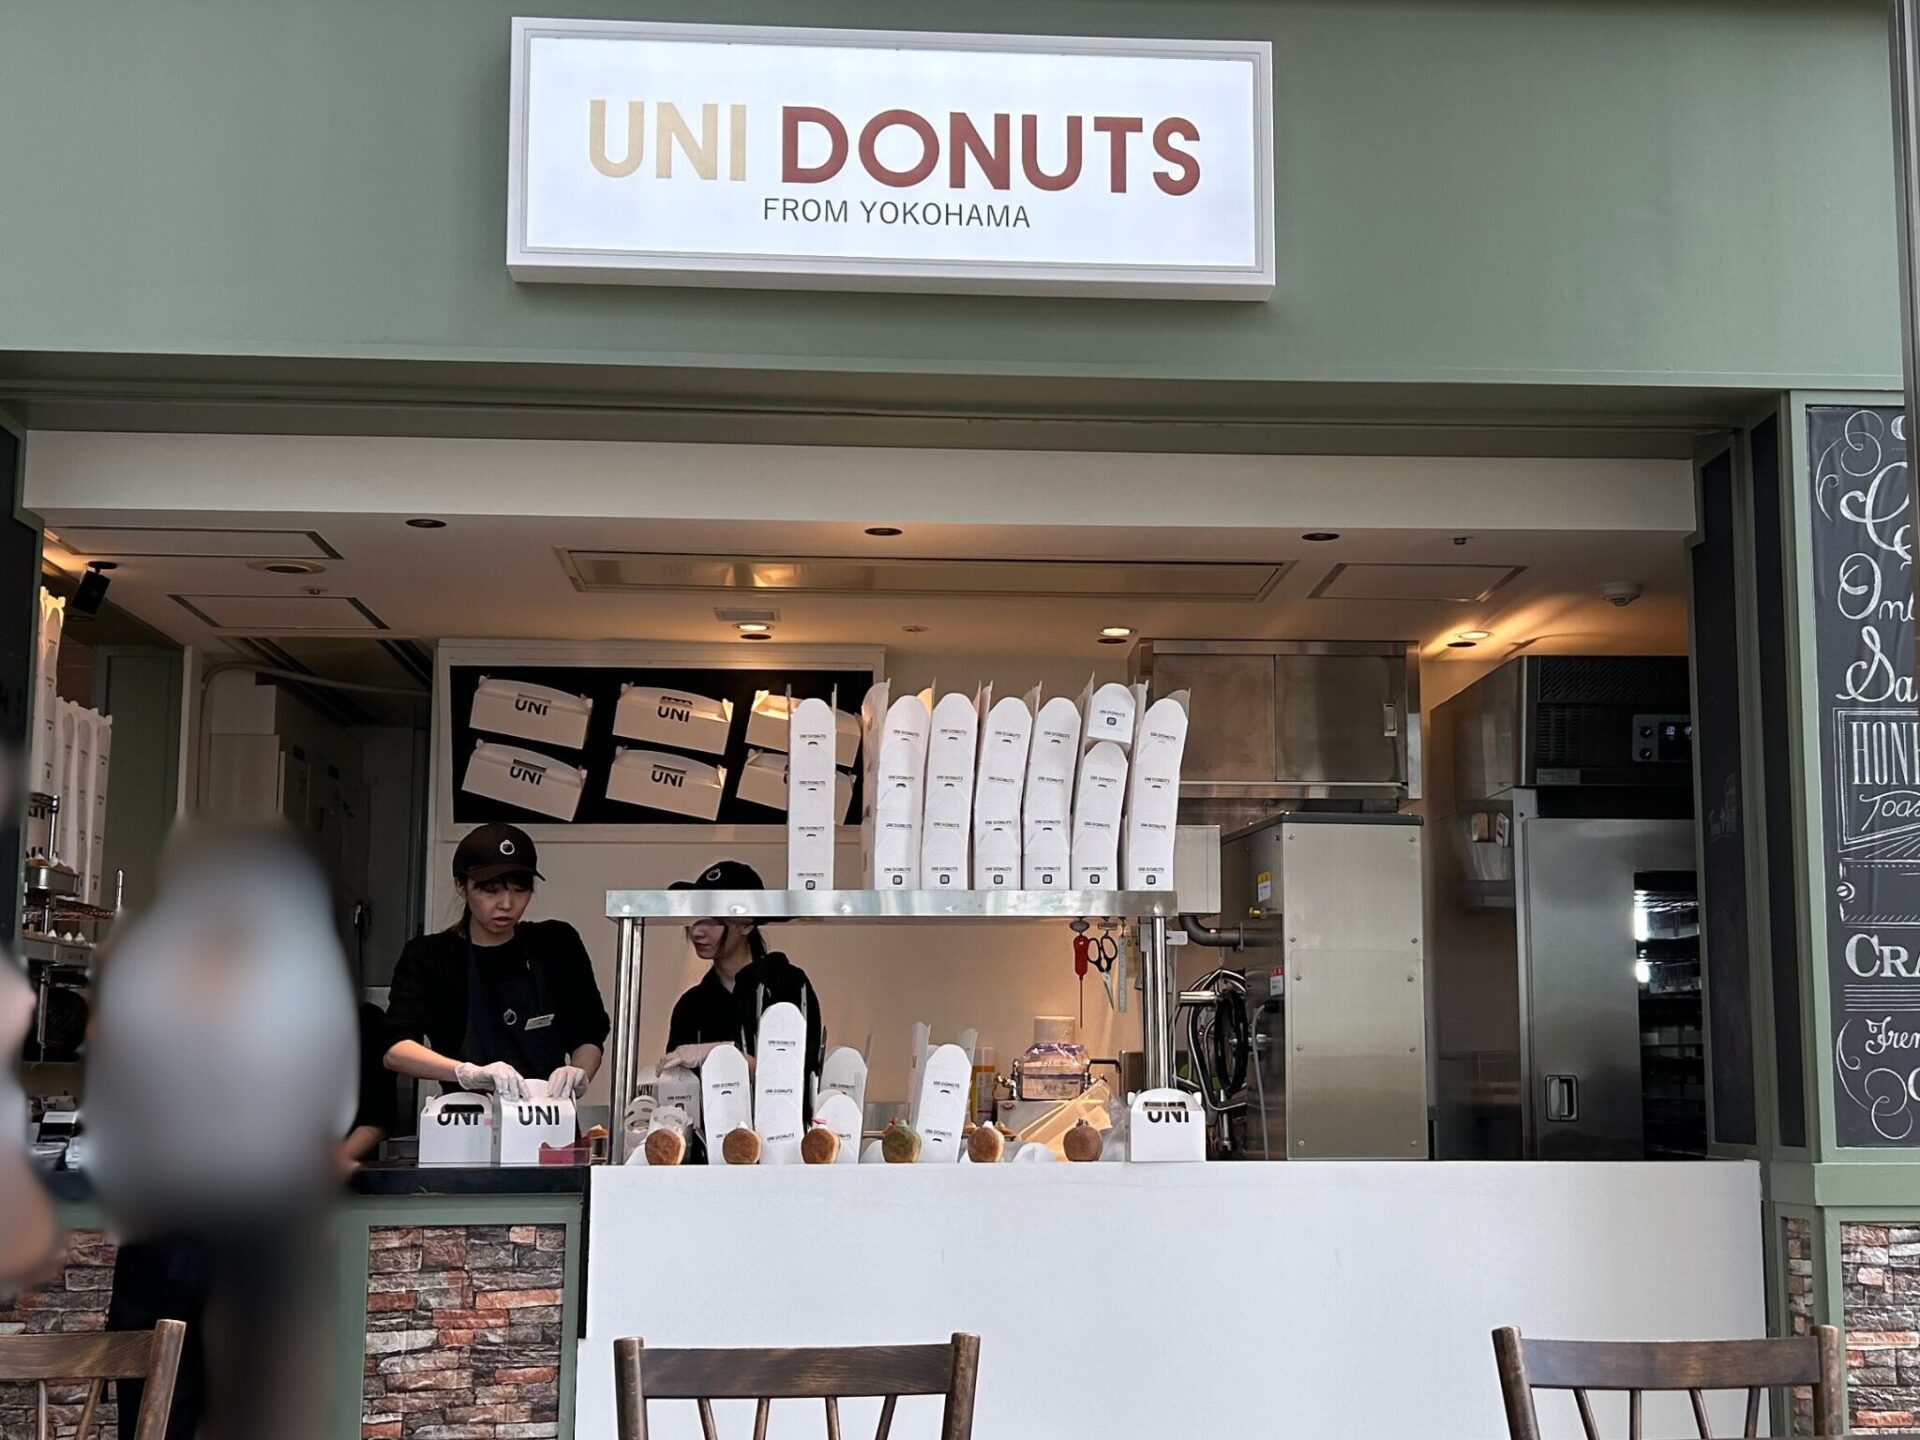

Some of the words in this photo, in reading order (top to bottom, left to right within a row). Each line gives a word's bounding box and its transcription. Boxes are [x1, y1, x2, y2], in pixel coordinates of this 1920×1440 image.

[589, 100, 747, 182] UNI
[781, 105, 1201, 197] DONUTS
[763, 198, 848, 224] FROM
[860, 200, 1031, 229] YOKOHAMA
[514, 698, 550, 717] UNI
[657, 706, 691, 724] UNI
[509, 766, 544, 787] UNI
[650, 769, 685, 788] UNI
[518, 1105, 560, 1126] UNI
